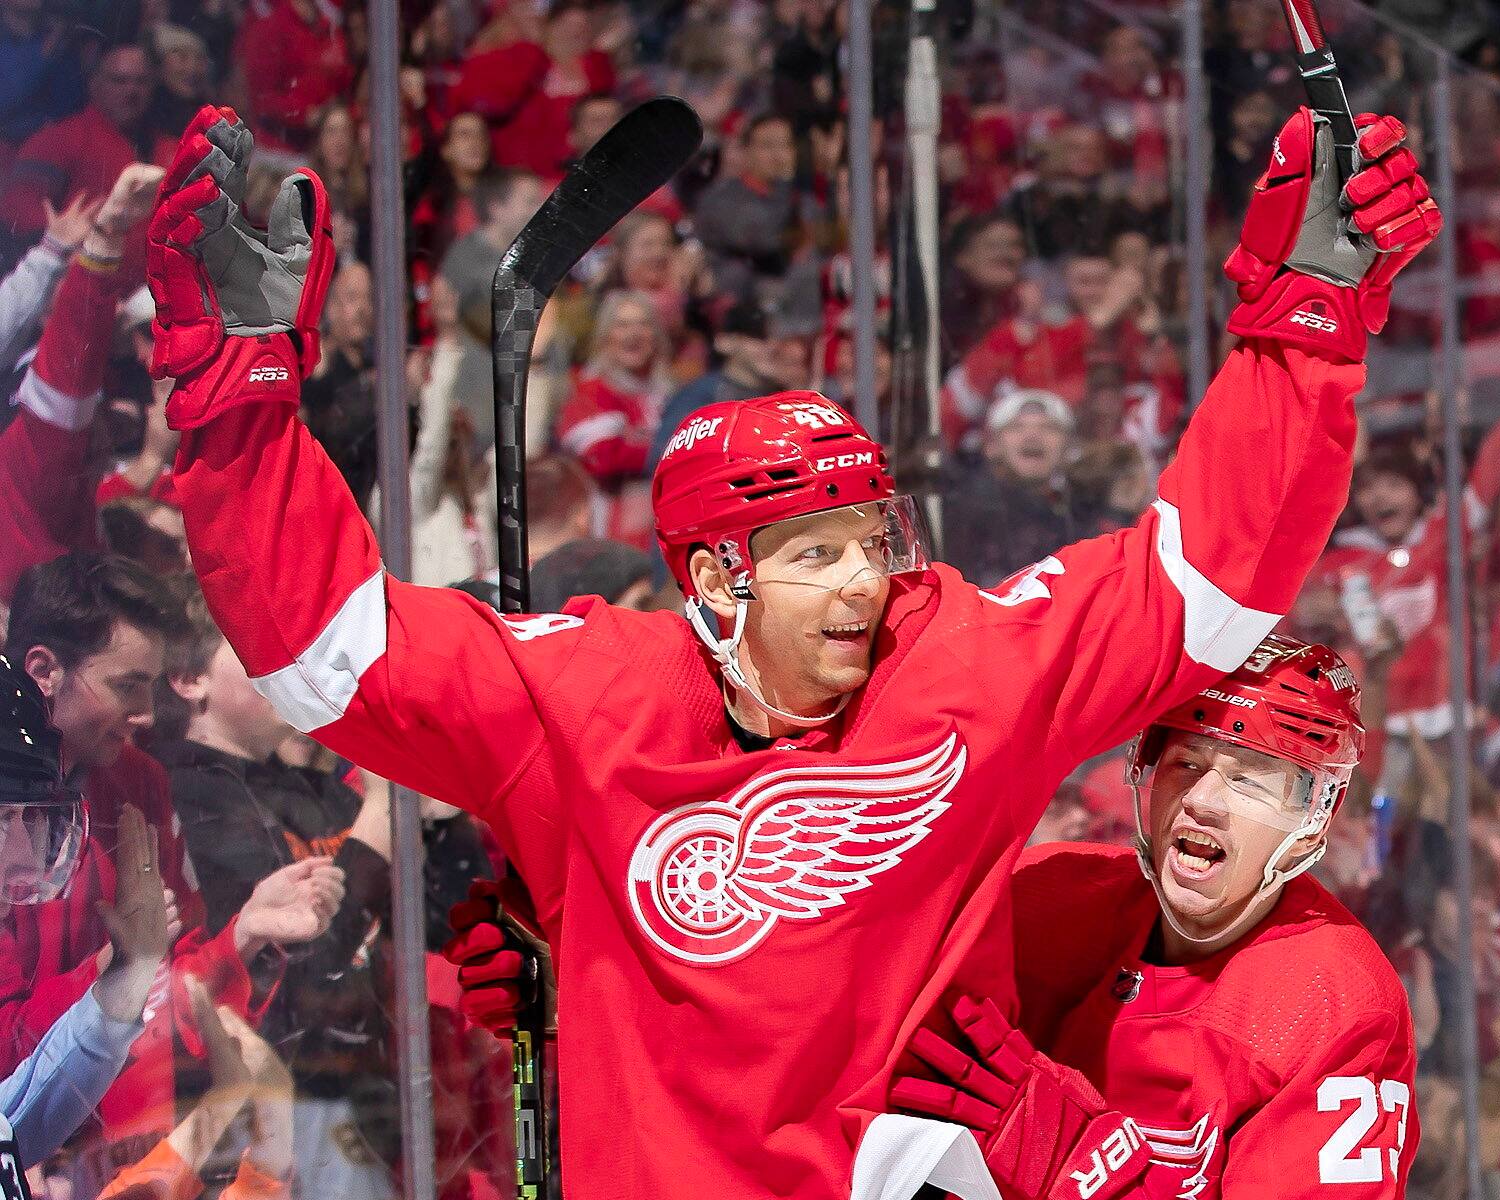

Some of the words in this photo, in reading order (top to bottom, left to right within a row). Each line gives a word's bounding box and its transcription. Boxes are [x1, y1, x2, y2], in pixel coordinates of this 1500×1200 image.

[1290, 314, 1337, 333] CCM
[249, 371, 288, 382] CCM
[816, 451, 873, 472] CCM
[1316, 1075, 1410, 1184] 23
